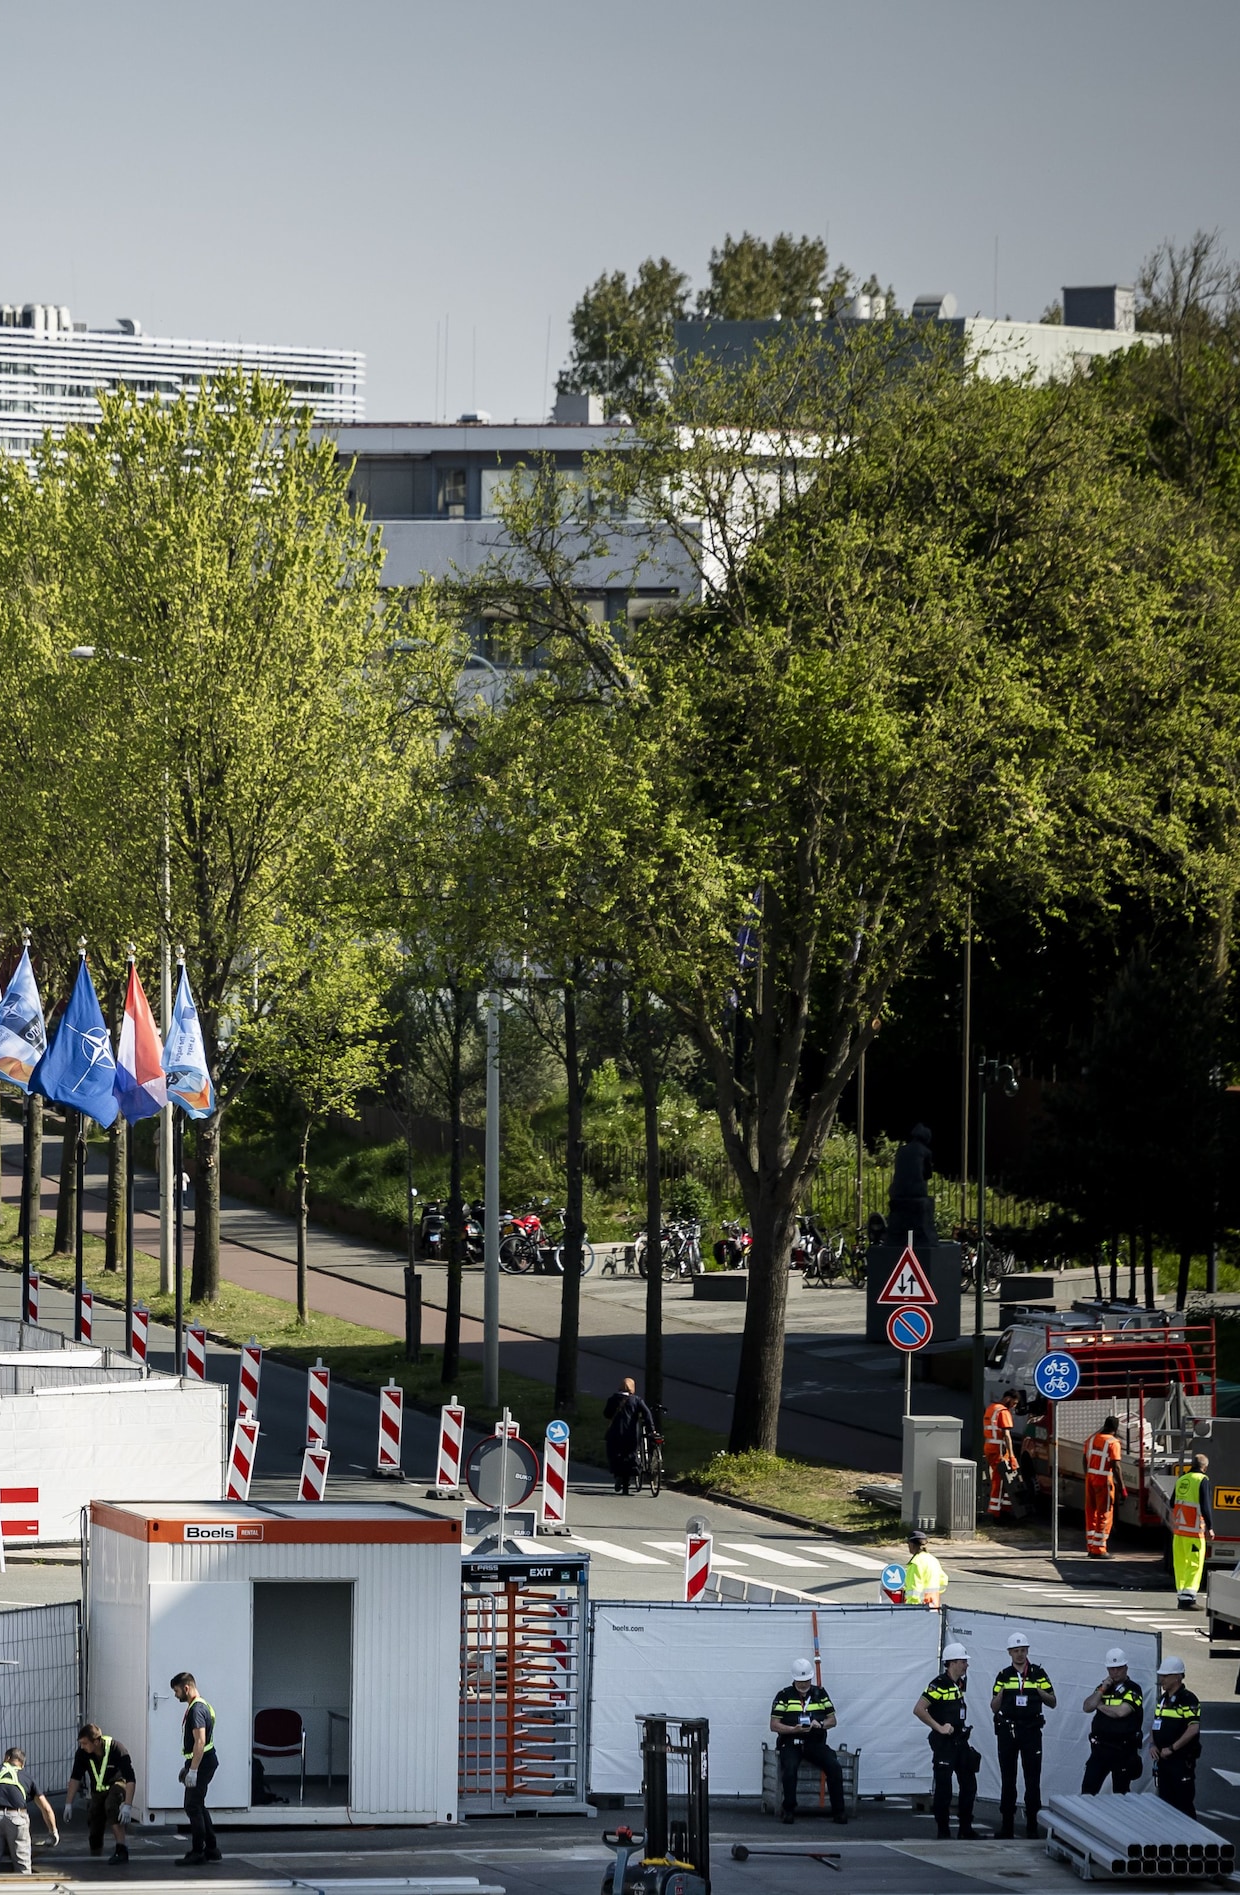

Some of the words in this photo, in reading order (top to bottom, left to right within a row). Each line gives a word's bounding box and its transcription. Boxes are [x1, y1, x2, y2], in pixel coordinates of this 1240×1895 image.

[186, 1527, 235, 1539] Boels
[240, 1529, 259, 1537] RENTAL
[529, 1568, 553, 1577] EXIT
[612, 1624, 645, 1633] boels.com
